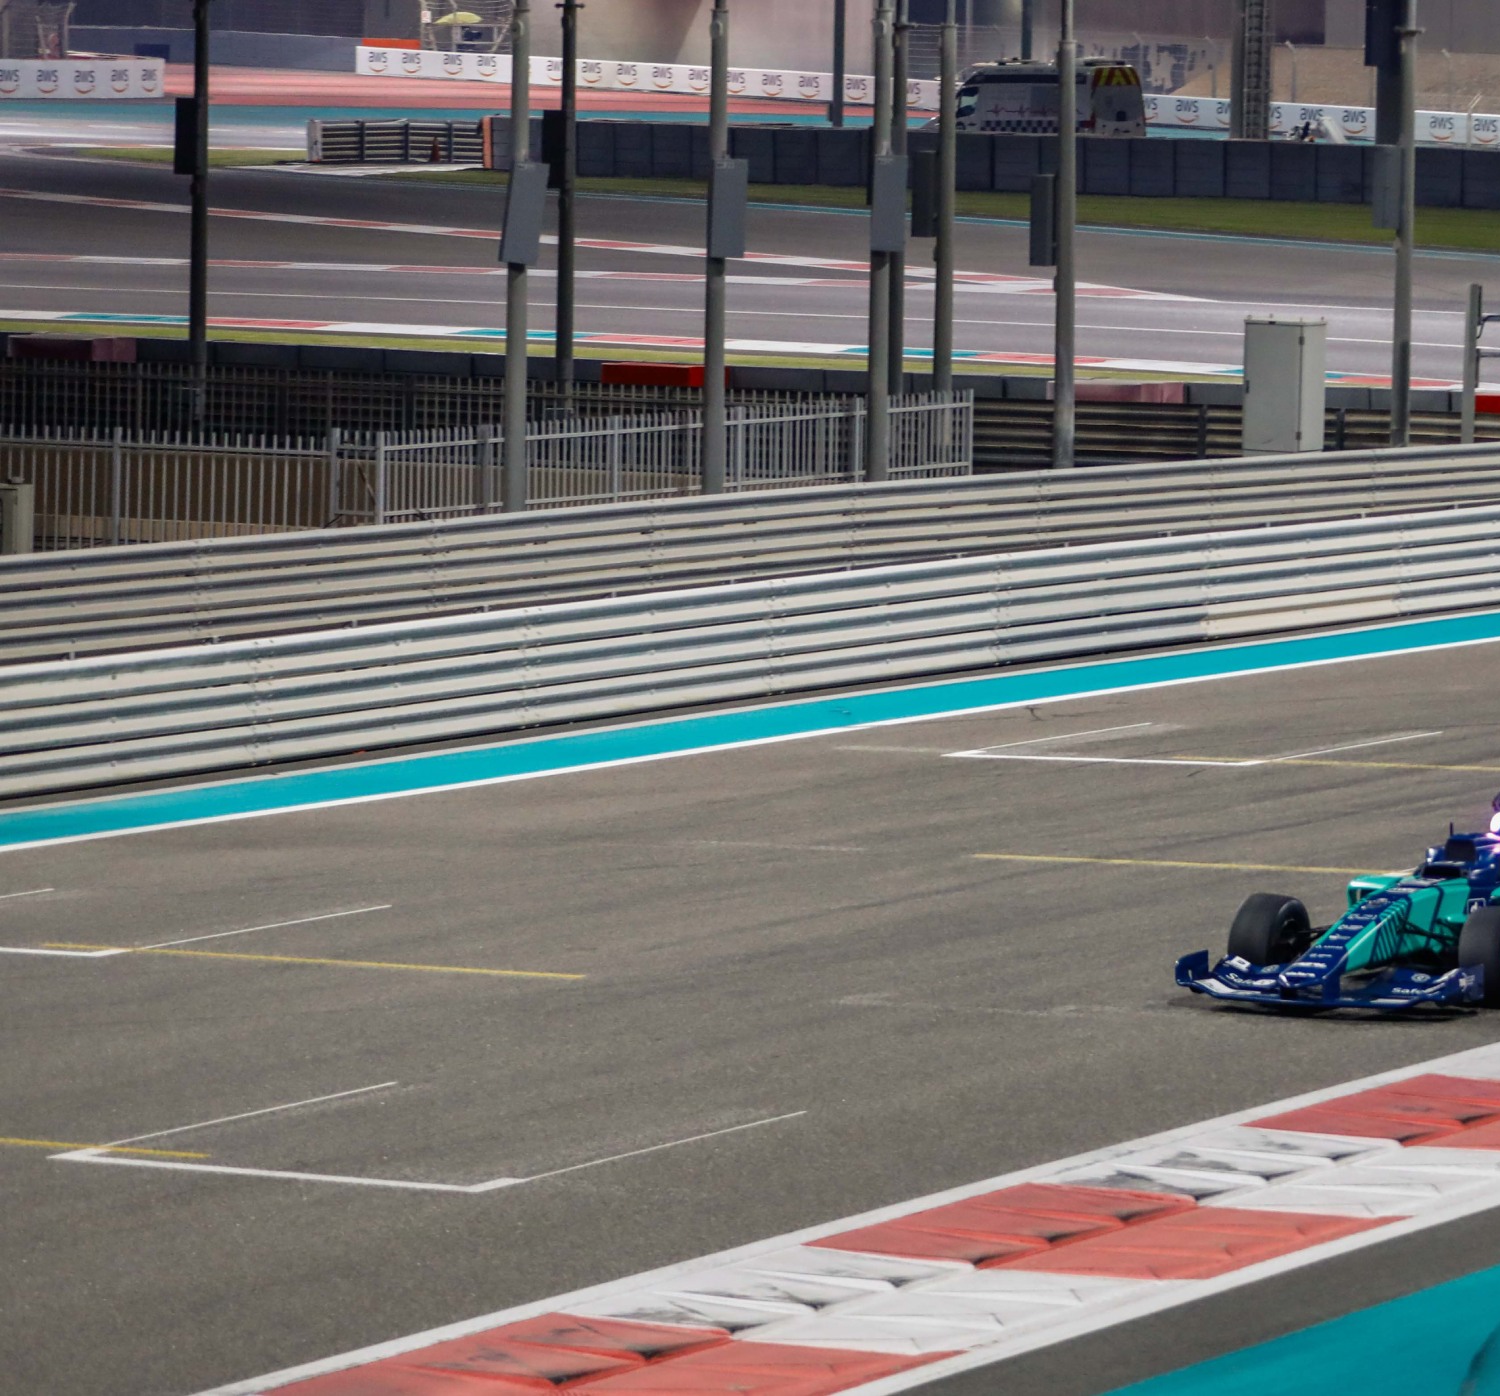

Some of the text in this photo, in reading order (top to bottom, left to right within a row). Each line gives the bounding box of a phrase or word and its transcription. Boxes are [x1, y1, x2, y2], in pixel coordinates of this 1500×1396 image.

[369, 51, 387, 63] aws
[402, 52, 421, 64] aws
[443, 54, 462, 66] aws
[477, 55, 496, 67] aws
[547, 60, 562, 71] aw
[581, 61, 601, 73] aws
[617, 63, 637, 76] aws
[37, 69, 58, 82] aws
[74, 70, 95, 83] aws
[111, 69, 129, 82] aws
[142, 69, 157, 82] aws
[652, 66, 672, 79] aws
[688, 69, 708, 82] aws
[762, 74, 782, 87] aws
[798, 75, 819, 88] aws
[846, 78, 867, 91] aws
[907, 82, 921, 95] ws
[1175, 99, 1199, 113] aws
[1300, 108, 1323, 121] aws
[1342, 110, 1367, 124] aws
[1429, 116, 1454, 130] aws
[1473, 118, 1498, 133] aws
